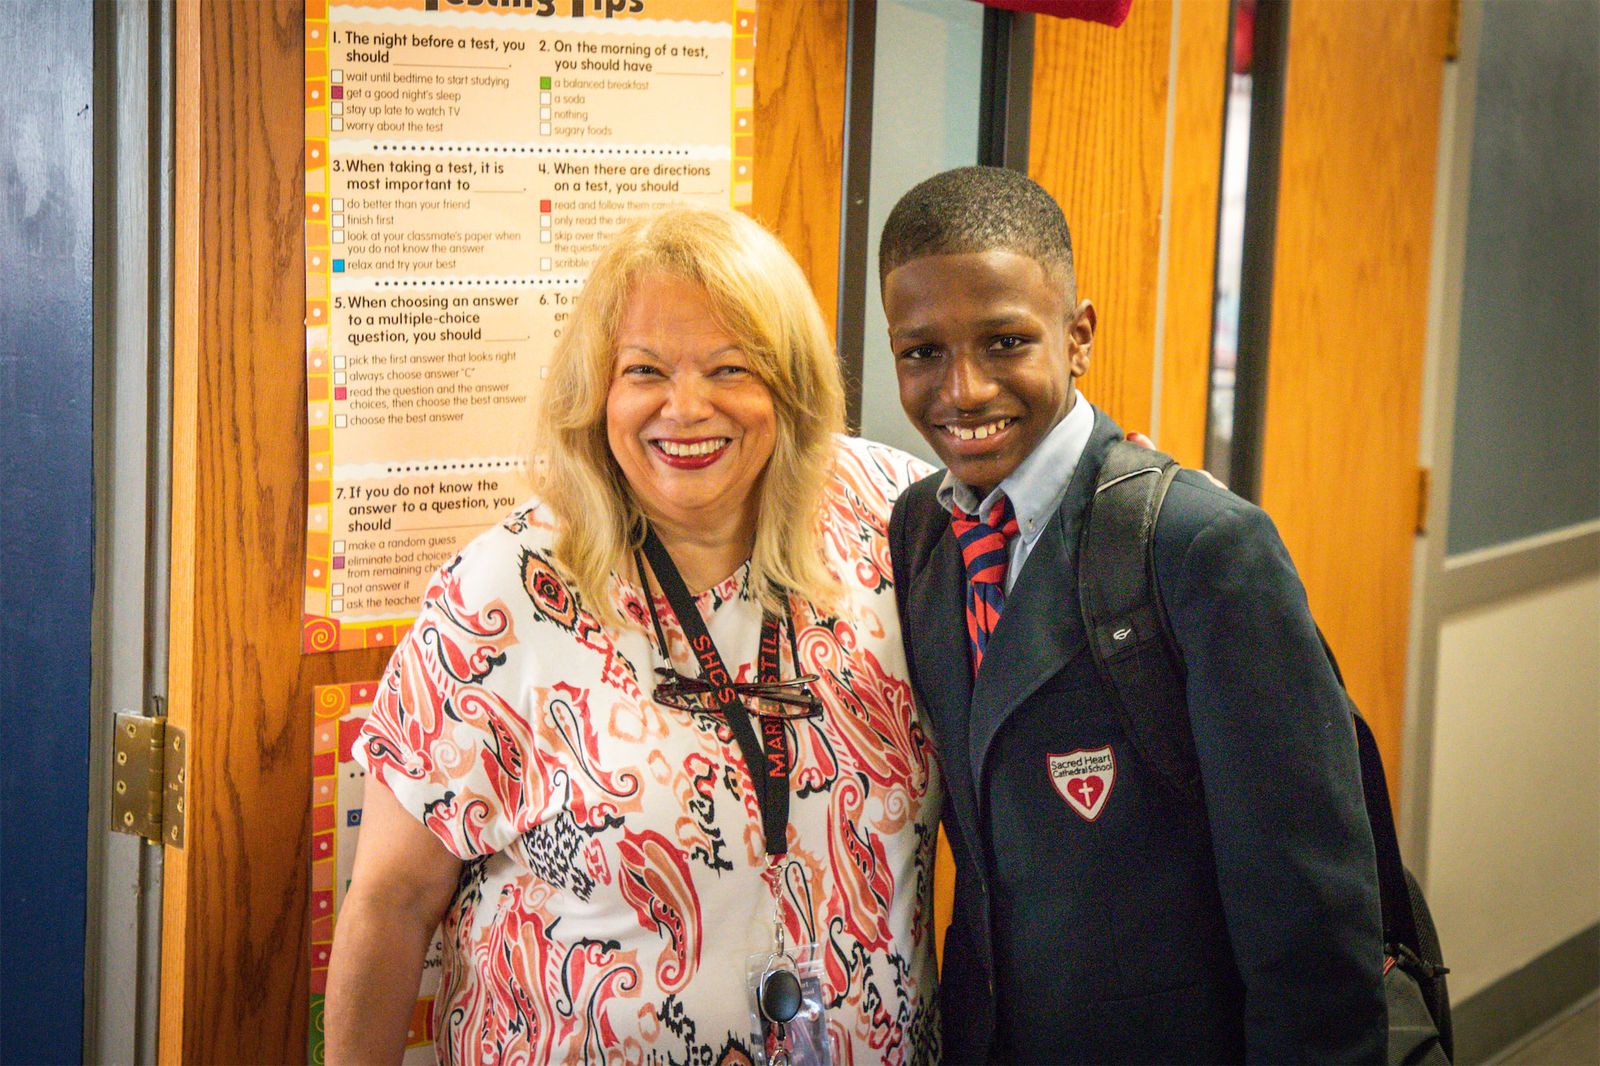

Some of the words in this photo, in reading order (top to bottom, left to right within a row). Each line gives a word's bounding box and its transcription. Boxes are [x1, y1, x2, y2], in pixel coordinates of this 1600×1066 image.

[346, 32, 369, 44] The
[374, 34, 407, 48] night
[412, 34, 453, 48] before
[458, 38, 465, 48] a
[471, 37, 498, 51] test,
[504, 41, 525, 51] you
[539, 40, 549, 52] 2.
[555, 40, 571, 52] On
[577, 43, 597, 54] the
[601, 45, 650, 58] morning
[655, 44, 667, 56] of
[671, 48, 678, 56] a
[683, 46, 708, 59] test,
[346, 50, 389, 63] should
[555, 60, 576, 72] you
[581, 59, 619, 70] should
[624, 61, 652, 72] have
[346, 72, 367, 82] wait
[371, 73, 390, 82] until
[394, 73, 433, 84] bedtime
[436, 75, 444, 84] to
[448, 75, 467, 84] start
[471, 76, 509, 88] studying
[564, 80, 605, 89] balanced
[608, 81, 649, 89] breakfast
[346, 89, 362, 100] get
[374, 89, 398, 101] good
[436, 91, 461, 102] sleep
[563, 94, 585, 104] soda
[346, 105, 366, 117] stay
[370, 107, 381, 116] up
[384, 105, 402, 115] late
[405, 106, 414, 115] to
[417, 106, 445, 116] watch
[449, 107, 460, 116] TV
[555, 110, 588, 121] nothing
[346, 122, 374, 132] worry
[377, 121, 404, 131] about
[408, 122, 423, 131] the
[426, 122, 443, 132] test
[555, 126, 584, 136] sugary
[588, 126, 612, 135] foods
[333, 160, 344, 172] 3.
[346, 160, 384, 173] When
[390, 162, 431, 176] taking
[436, 165, 443, 173] a
[449, 162, 477, 175] test,
[481, 162, 490, 174] it
[494, 163, 504, 174] is
[539, 164, 549, 174] 4.
[554, 163, 589, 175] When
[594, 164, 626, 175] there
[630, 166, 649, 176] are
[654, 164, 710, 176] directions
[347, 178, 380, 190] most
[386, 178, 451, 192] important
[457, 179, 470, 190] to
[555, 182, 569, 191] on
[574, 183, 580, 191] a
[586, 181, 611, 193] test,
[616, 182, 637, 194] you
[641, 180, 679, 192] should
[347, 200, 359, 208] do
[363, 199, 391, 209] better
[395, 200, 416, 209] than
[420, 201, 440, 211] your
[443, 200, 470, 209] friend
[347, 214, 373, 224] finish
[376, 215, 394, 224] first
[347, 231, 367, 240] look
[371, 231, 380, 240] at
[383, 232, 404, 242] your
[465, 233, 492, 243] paper
[495, 231, 520, 240] when
[348, 260, 372, 269] relax
[376, 260, 394, 269] and
[398, 261, 409, 271] try
[413, 261, 432, 270] your
[436, 260, 456, 269] best
[334, 297, 345, 309] 5.
[348, 296, 386, 308] When
[391, 296, 448, 310] choosing
[453, 296, 468, 307] an
[473, 296, 519, 306] answer
[540, 294, 549, 305] 6.
[554, 293, 567, 304] To
[349, 315, 361, 325] to
[366, 316, 374, 325] a
[379, 313, 480, 327] multiple-choice
[348, 330, 408, 344] question,
[413, 331, 436, 344] you
[440, 328, 481, 341] should
[349, 356, 368, 367] pick
[372, 355, 386, 365] the
[390, 355, 407, 364] first
[410, 355, 444, 364] answer
[448, 354, 466, 363] that
[468, 352, 493, 362] looks
[496, 352, 516, 364] right
[350, 372, 384, 383] always
[387, 370, 422, 380] choose
[424, 369, 458, 379] answer
[350, 414, 385, 426] choose
[388, 414, 403, 424] the
[406, 413, 426, 423] best
[429, 412, 464, 422] answer
[336, 488, 346, 499] 7.
[350, 486, 360, 498] If
[366, 488, 389, 500] you
[394, 484, 409, 496] do
[414, 483, 434, 494] not
[440, 482, 473, 494] know
[478, 480, 498, 491] the
[349, 503, 397, 515] answer
[403, 502, 415, 512] to
[420, 503, 427, 511] a
[432, 497, 488, 513] question,
[493, 496, 515, 508] you
[348, 519, 391, 532] should
[349, 542, 376, 550] make
[388, 538, 426, 548] random
[428, 537, 456, 547] guess
[348, 556, 392, 566] eliminate
[395, 554, 414, 562] bad
[417, 551, 452, 561] choices
[348, 569, 370, 578] from
[373, 566, 421, 579] remaining
[347, 583, 362, 593] not
[366, 582, 400, 592] answer
[403, 580, 410, 589] it
[347, 600, 363, 609] ask
[367, 598, 381, 608] the
[385, 595, 420, 606] teacher
[694, 634, 736, 704] SHCS
[1051, 758, 1082, 770] Sacred
[1085, 754, 1111, 764] Heart
[1053, 767, 1087, 778] Cathedral
[1089, 763, 1112, 773] School
